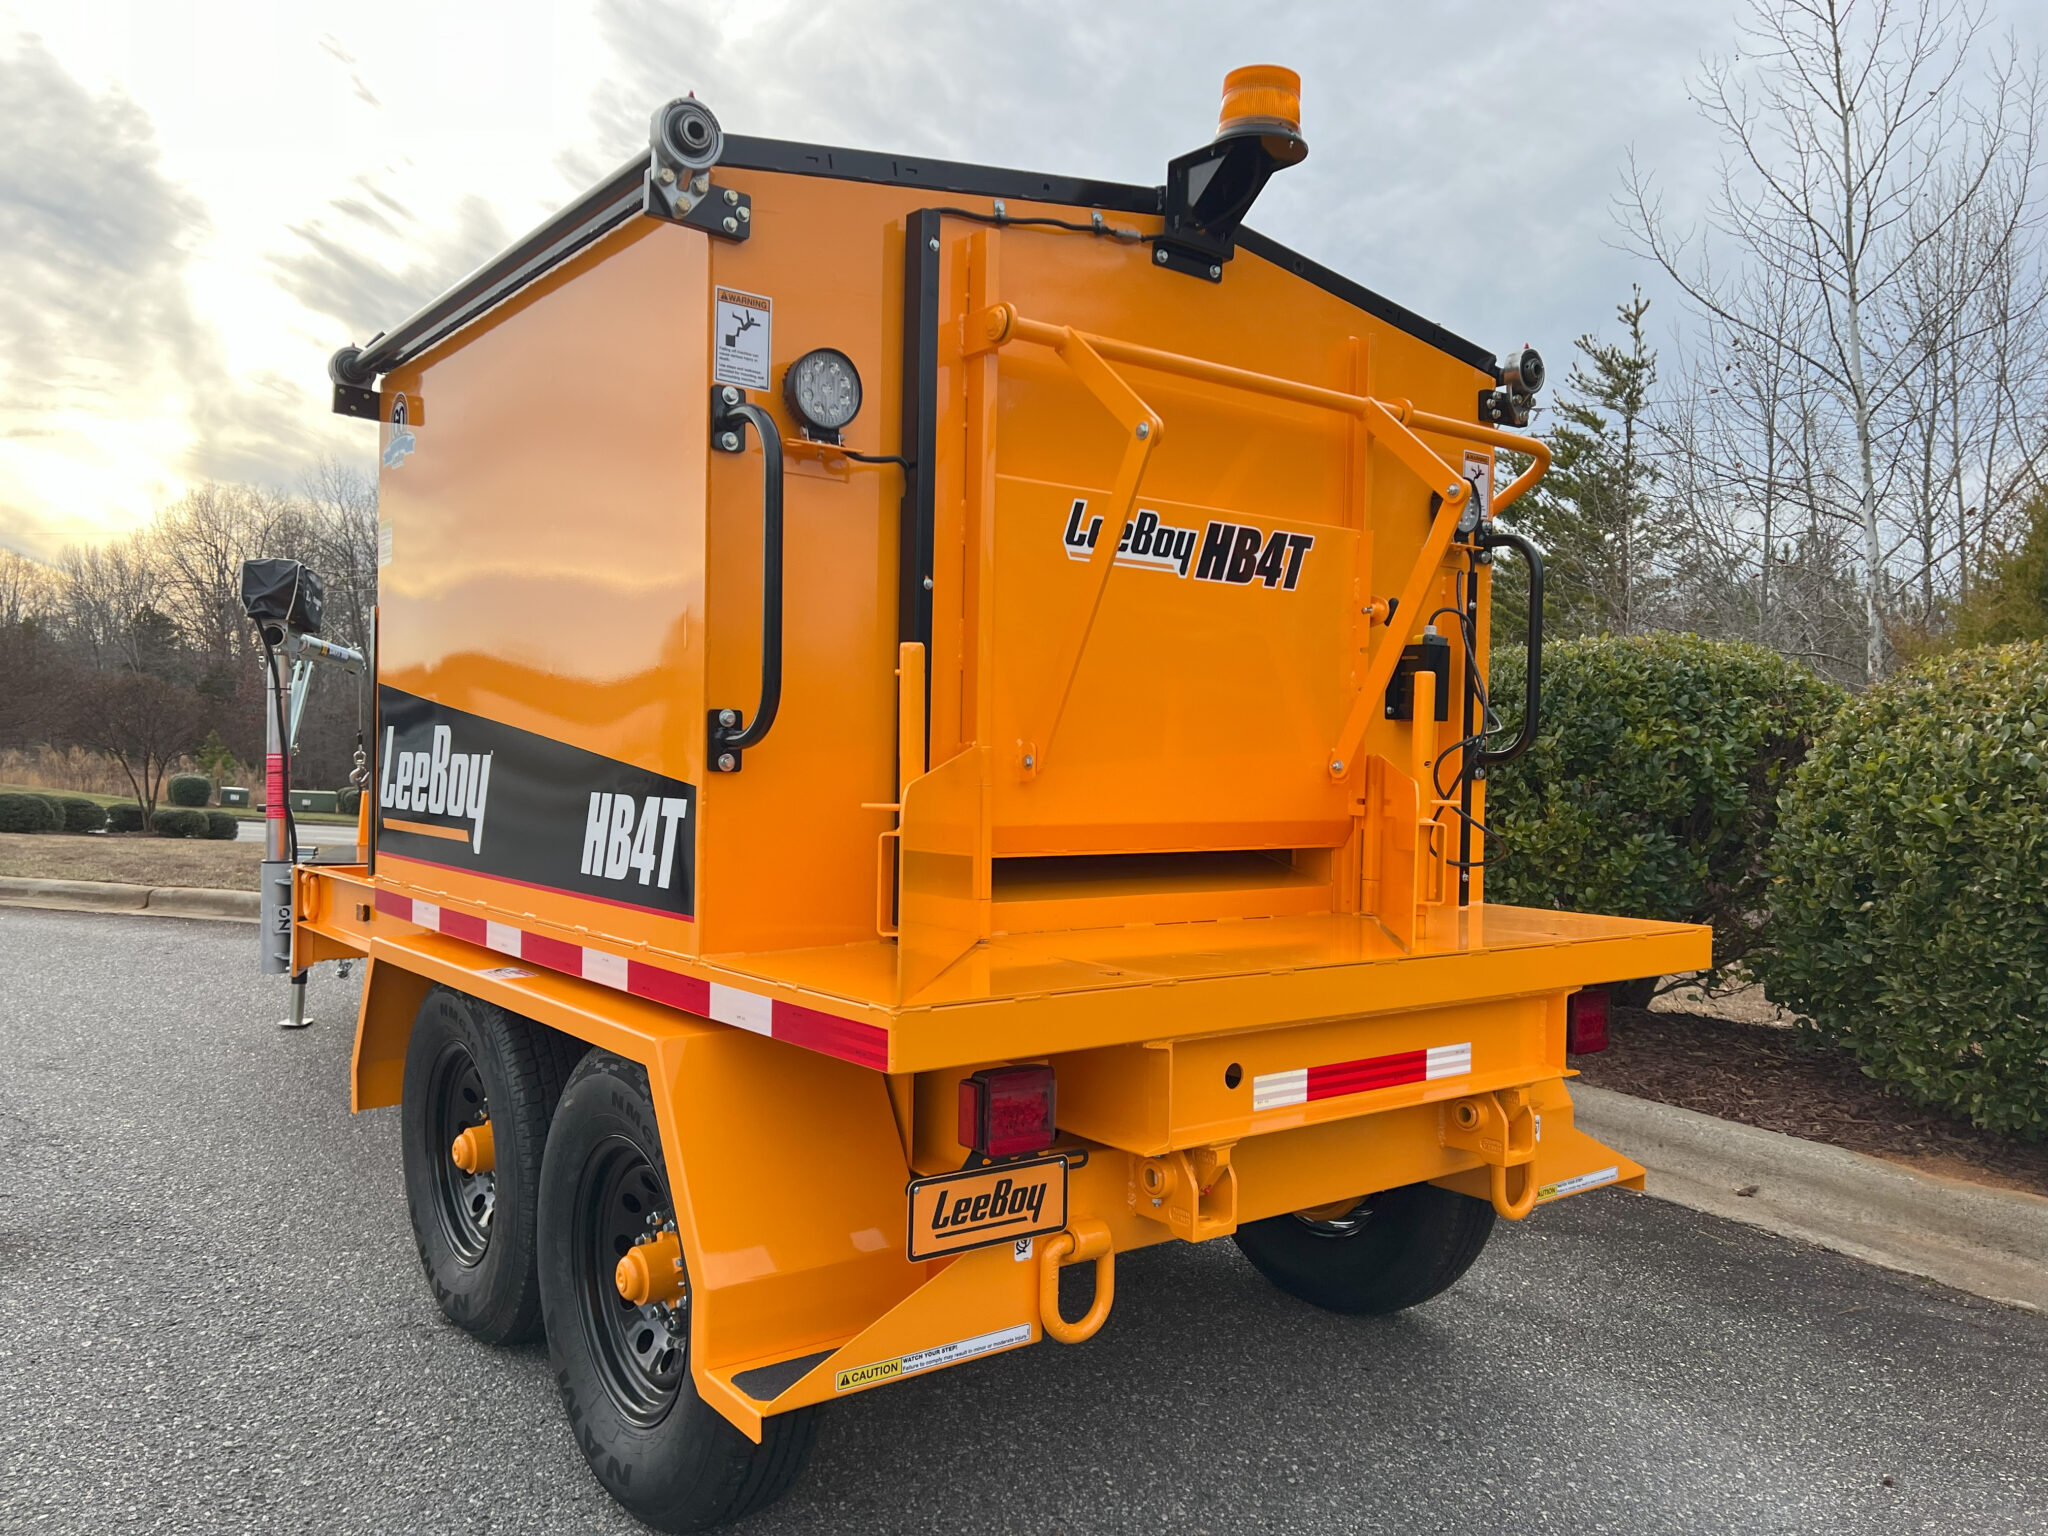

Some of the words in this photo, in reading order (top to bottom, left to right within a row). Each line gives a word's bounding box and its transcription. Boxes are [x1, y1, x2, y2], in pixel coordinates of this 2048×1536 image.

[728, 293, 767, 309] WARNING
[1196, 522, 1314, 590] HB4T
[380, 725, 491, 855] LeeBoy
[581, 792, 687, 889] HB4T
[931, 1179, 1047, 1230] LeeBoy
[1537, 1187, 1556, 1197] AUTION
[851, 1362, 898, 1383] CAUTION
[902, 1354, 923, 1364] WATCH
[924, 1349, 941, 1358] YOUR
